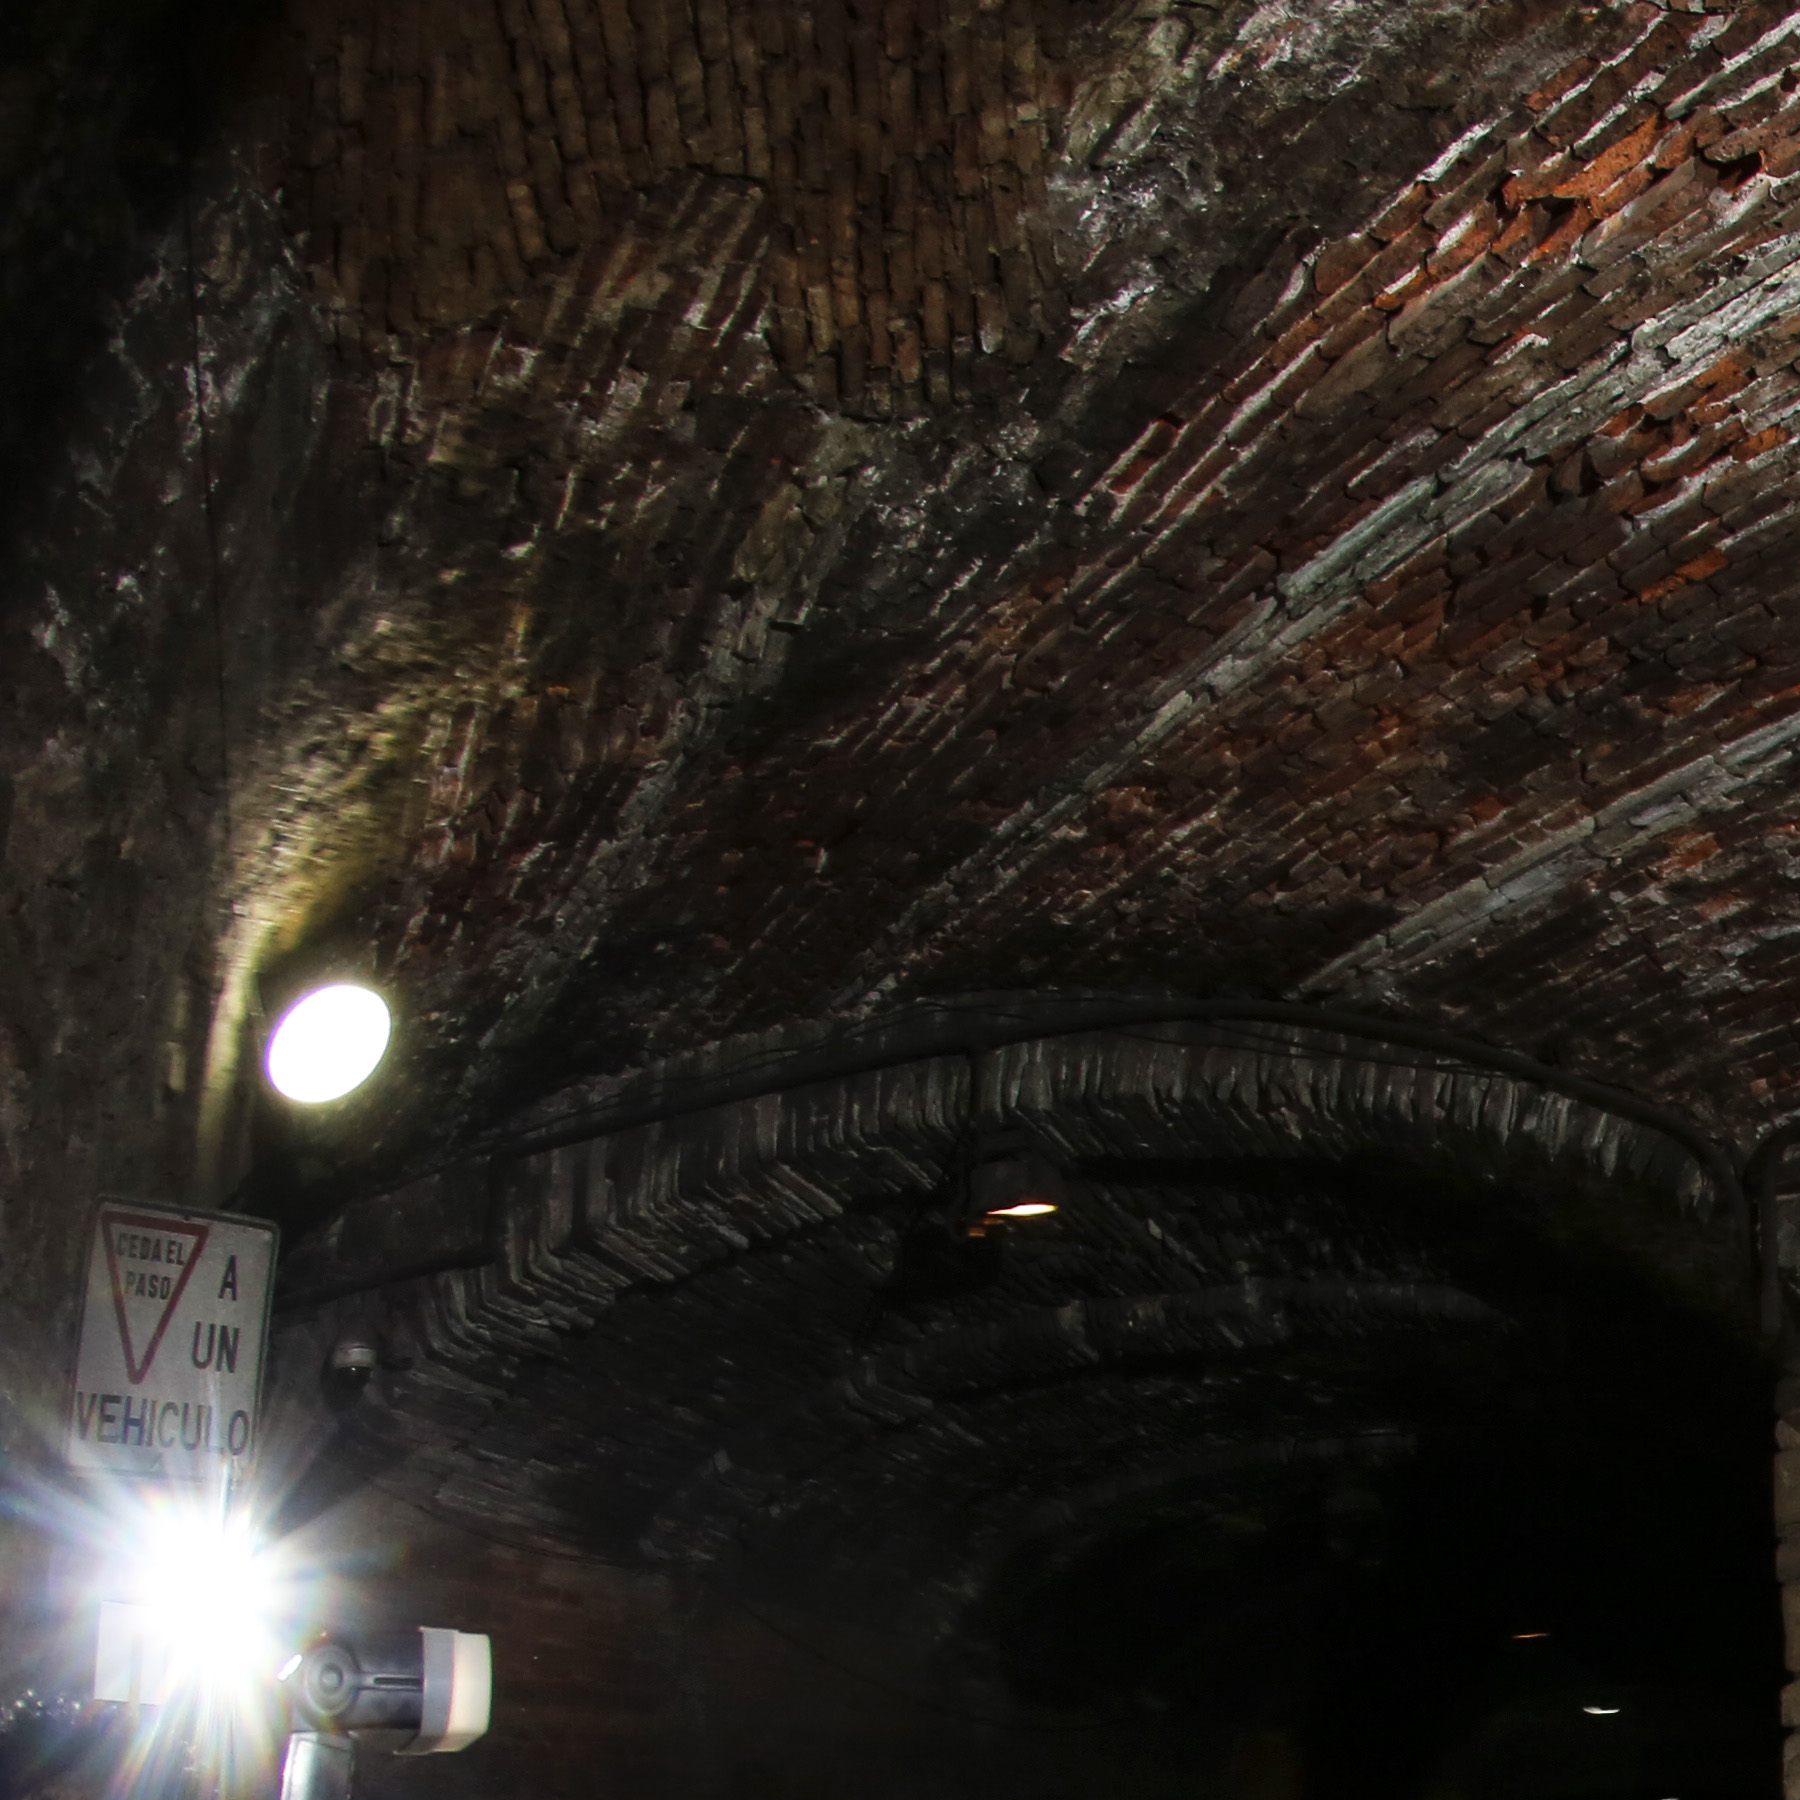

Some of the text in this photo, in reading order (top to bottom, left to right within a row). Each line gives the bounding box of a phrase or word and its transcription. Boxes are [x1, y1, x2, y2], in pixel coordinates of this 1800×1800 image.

[116, 1231, 186, 1266] CEDA EL
[125, 1270, 172, 1300] PASO
[217, 1254, 238, 1302] A
[192, 1321, 241, 1374] UN
[76, 1390, 250, 1457] VEHICULO
